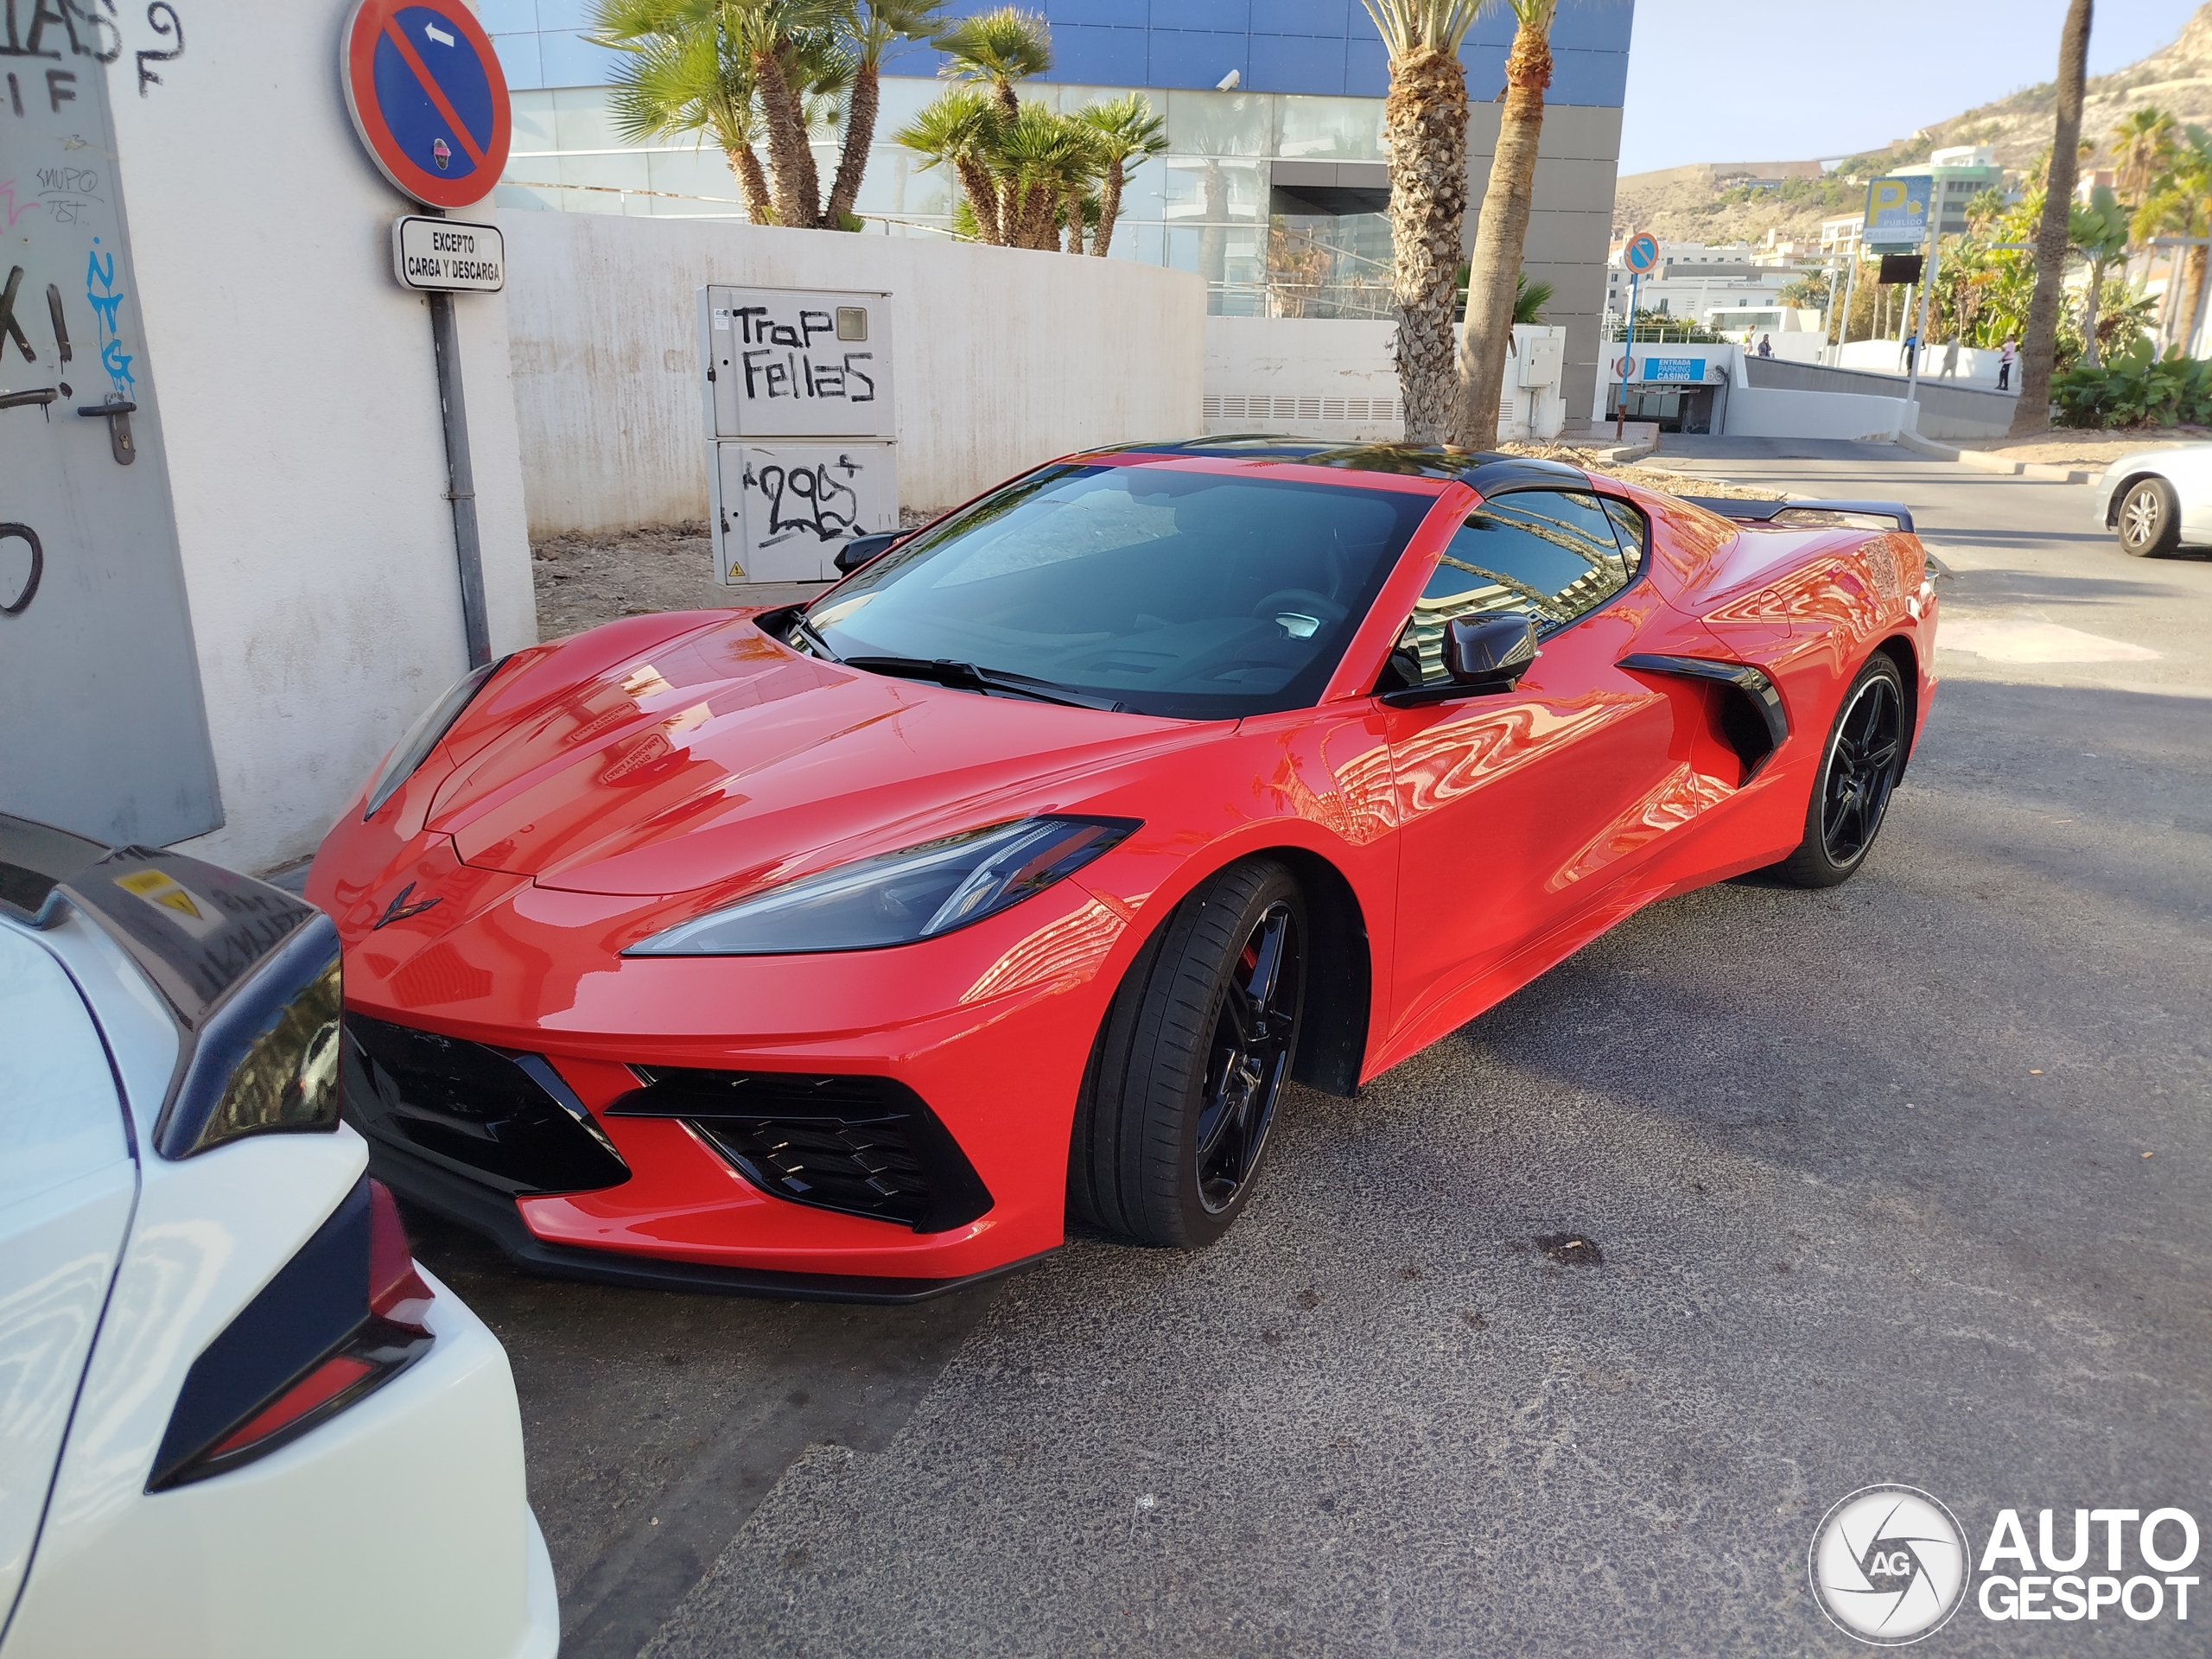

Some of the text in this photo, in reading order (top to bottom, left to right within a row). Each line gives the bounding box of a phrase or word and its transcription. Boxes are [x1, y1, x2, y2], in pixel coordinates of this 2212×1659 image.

[1867, 180, 1908, 227] P
[433, 232, 474, 254] EXCEPTO
[1866, 231, 1907, 240] CASINO
[409, 257, 500, 282] CARGA Y DESCARGA
[1656, 372, 1690, 381] CASINO
